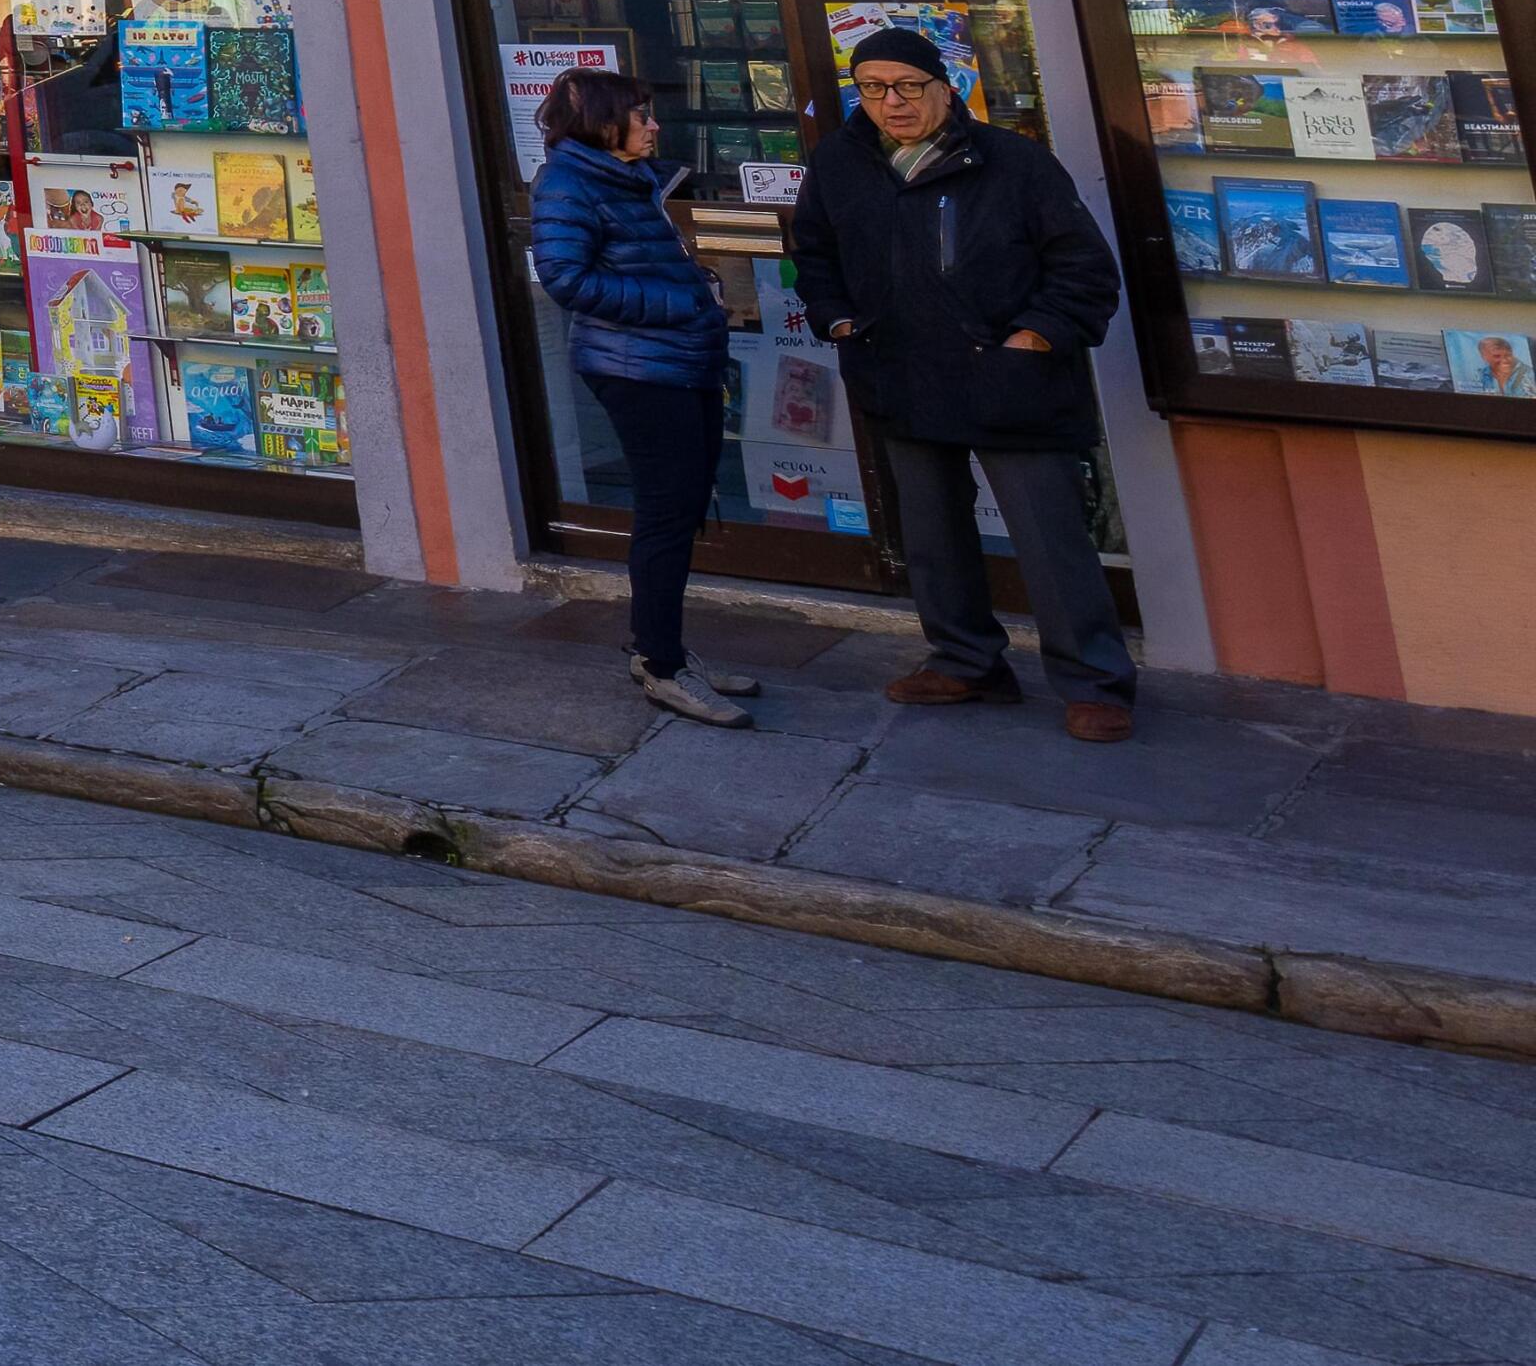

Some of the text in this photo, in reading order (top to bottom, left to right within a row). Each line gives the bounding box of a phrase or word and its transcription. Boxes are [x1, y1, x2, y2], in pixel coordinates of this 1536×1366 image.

[132, 31, 190, 41] IN ALTO!
[580, 52, 602, 65] LAB
[235, 71, 268, 86] MOSTRI
[1209, 116, 1263, 125] BOULDERING
[1306, 125, 1356, 138] poco
[783, 187, 799, 196] ARE
[775, 337, 823, 348] DONA UN
[280, 397, 316, 409] MAPPE
[772, 459, 827, 474] SCUOLA
